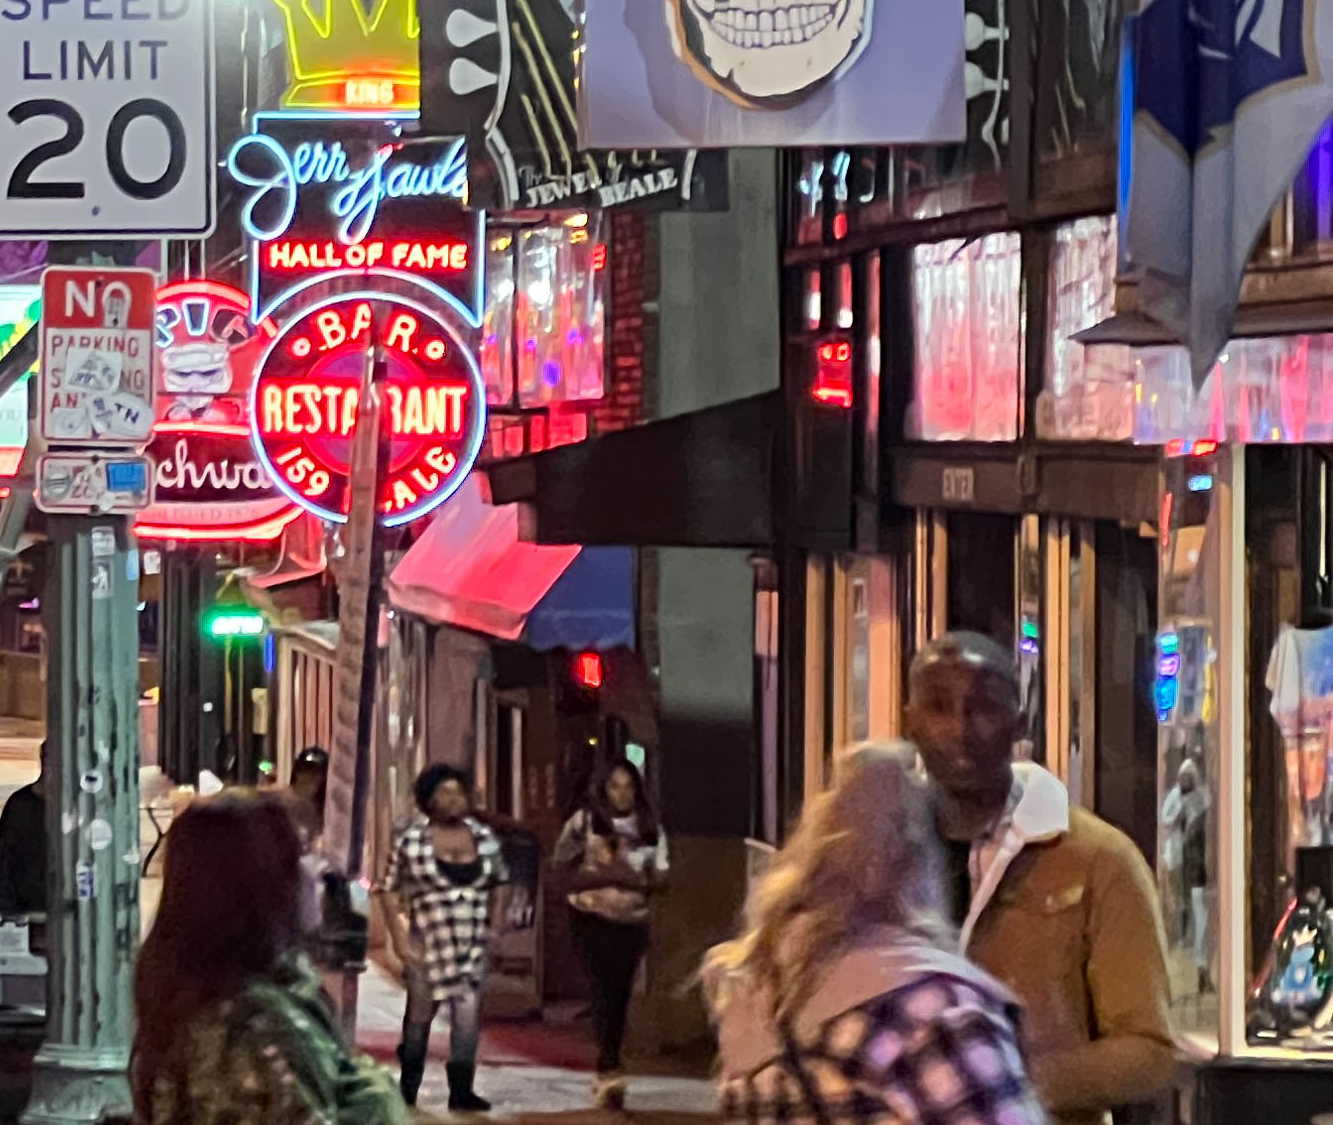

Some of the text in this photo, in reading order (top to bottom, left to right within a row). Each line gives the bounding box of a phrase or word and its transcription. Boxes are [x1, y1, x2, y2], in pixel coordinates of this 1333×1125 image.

[23, 40, 168, 80] LIMIT
[346, 80, 394, 104] KING
[7, 97, 187, 201] 20
[599, 167, 678, 207] BEALE
[270, 243, 467, 268] HALL OF FAME
[51, 391, 87, 413] AN
[263, 383, 467, 436] RESTARANT
[156, 438, 277, 490] chwa
[277, 446, 457, 513] 159 ALE
